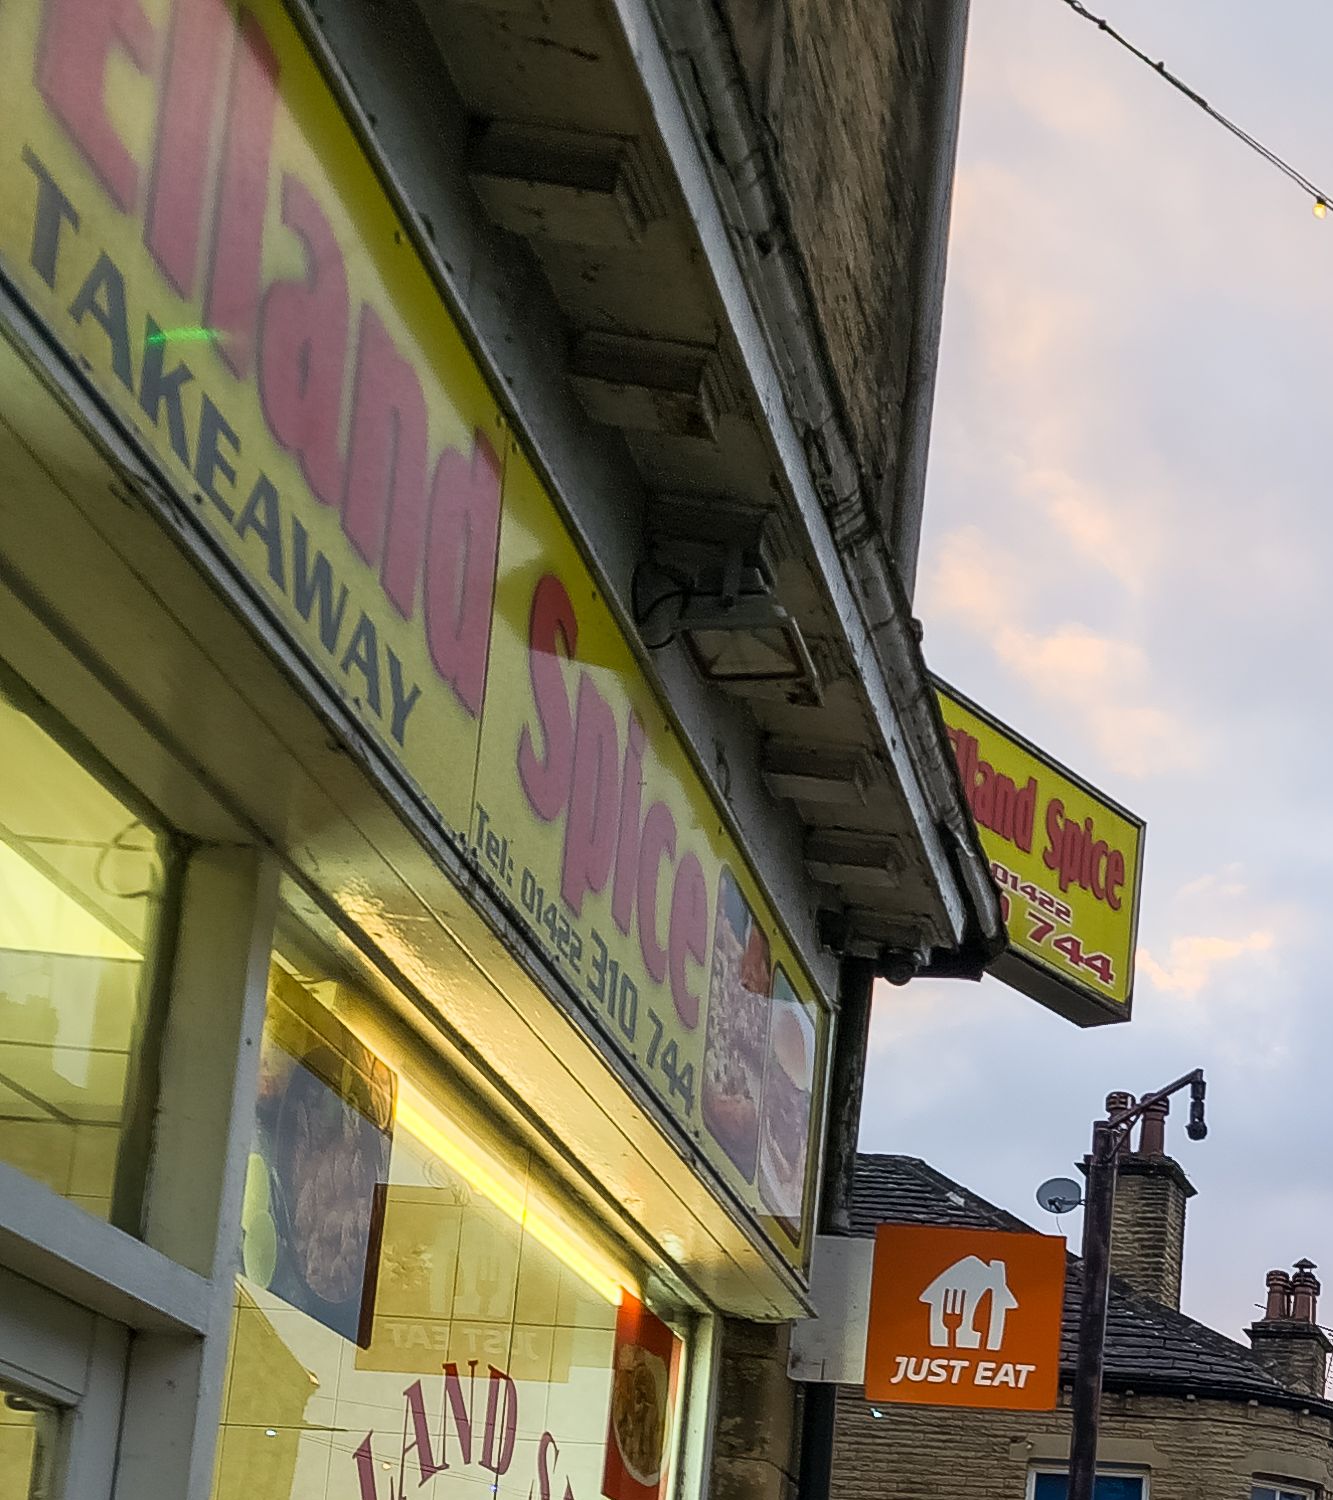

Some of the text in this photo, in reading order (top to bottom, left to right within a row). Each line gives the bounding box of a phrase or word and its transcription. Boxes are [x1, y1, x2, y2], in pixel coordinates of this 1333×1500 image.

[21, 144, 421, 747] TAKEAWAY
[516, 575, 707, 1031] Spice
[1043, 798, 1125, 911] Spice
[472, 808, 697, 1114] Tel: 01422 310 744
[1027, 909, 1115, 987] 744
[890, 1356, 1036, 1389] JUST EAT
